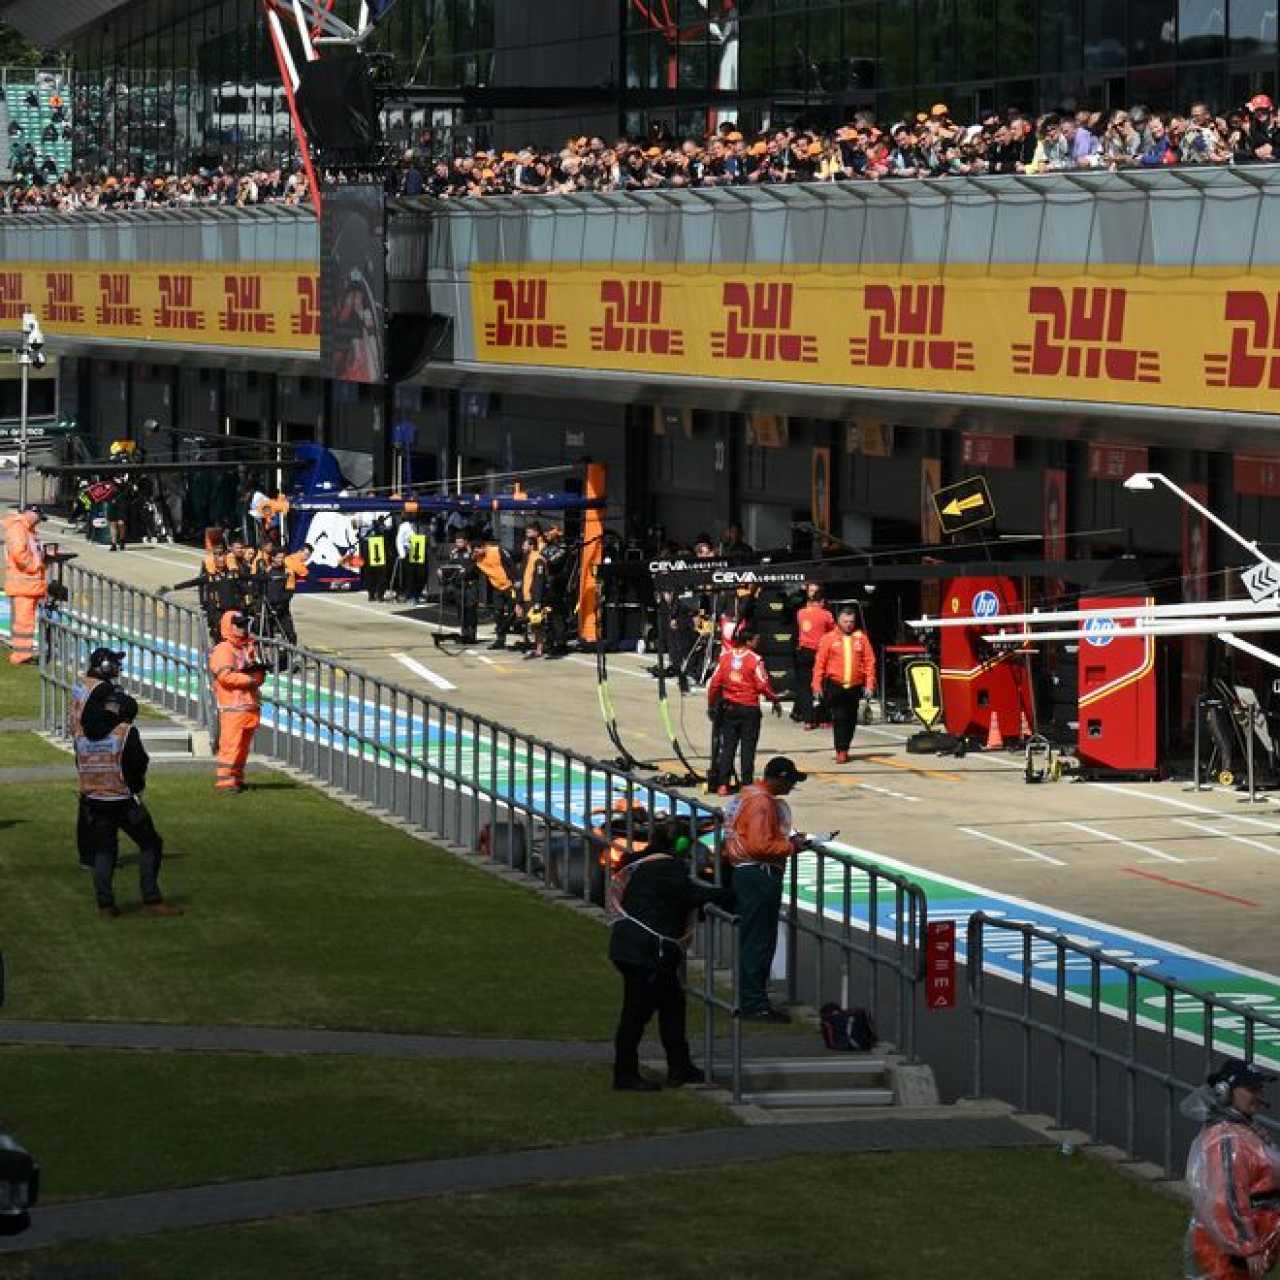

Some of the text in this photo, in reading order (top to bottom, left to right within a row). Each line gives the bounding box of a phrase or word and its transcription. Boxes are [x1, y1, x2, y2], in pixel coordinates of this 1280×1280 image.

[46, 273, 78, 322] DHL
[100, 274, 136, 325] DHL
[158, 275, 198, 329] DHL
[224, 276, 267, 332] DHL
[493, 278, 548, 349] DHL
[600, 280, 670, 355] DHL
[722, 282, 802, 362] DHL
[863, 283, 955, 371] DHL
[1028, 285, 1138, 381] DHL
[712, 571, 757, 583] CEVA
